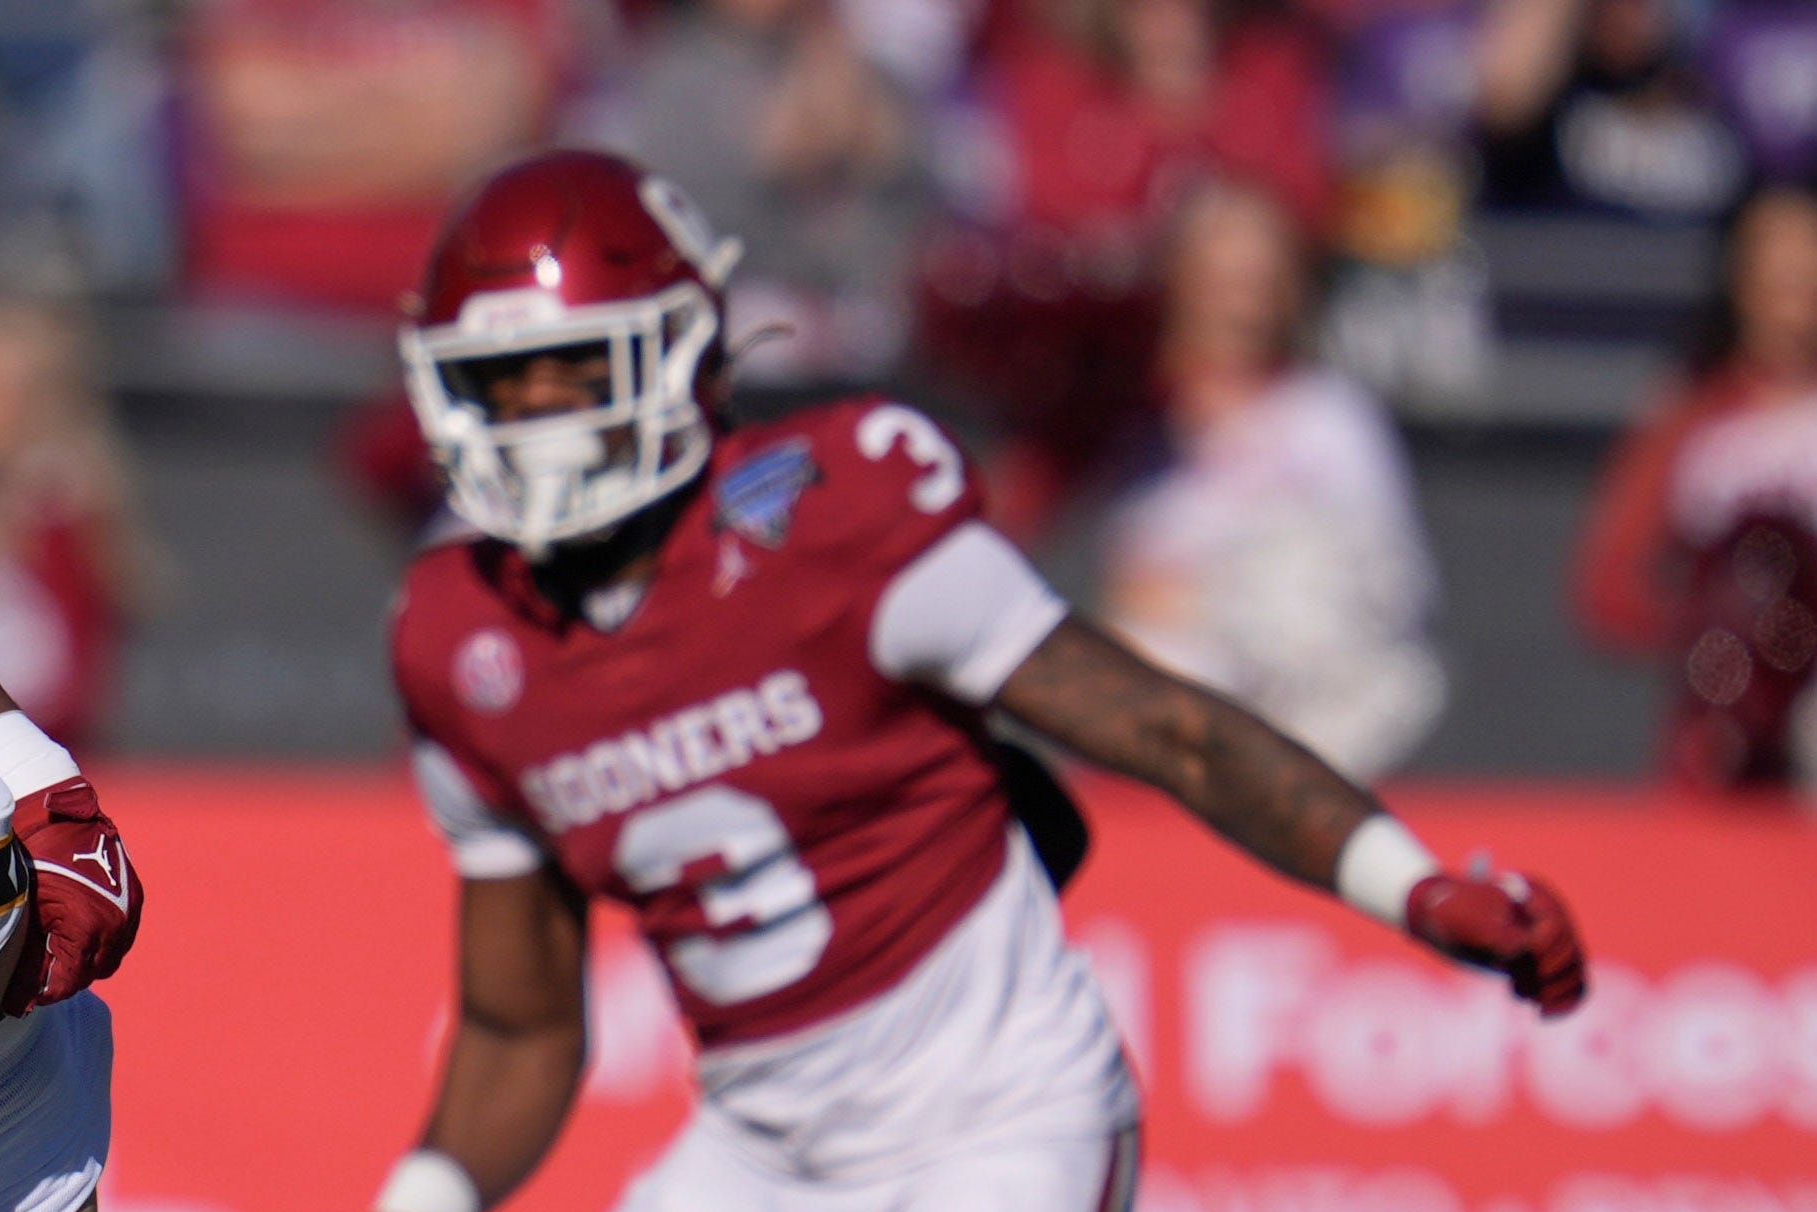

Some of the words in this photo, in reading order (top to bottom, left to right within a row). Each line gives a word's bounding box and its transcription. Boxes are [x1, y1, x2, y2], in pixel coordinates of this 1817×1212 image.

[856, 405, 966, 516] 3
[522, 669, 824, 835] SOONERS
[613, 785, 834, 1005] 3
[1190, 925, 1817, 1125] Force
